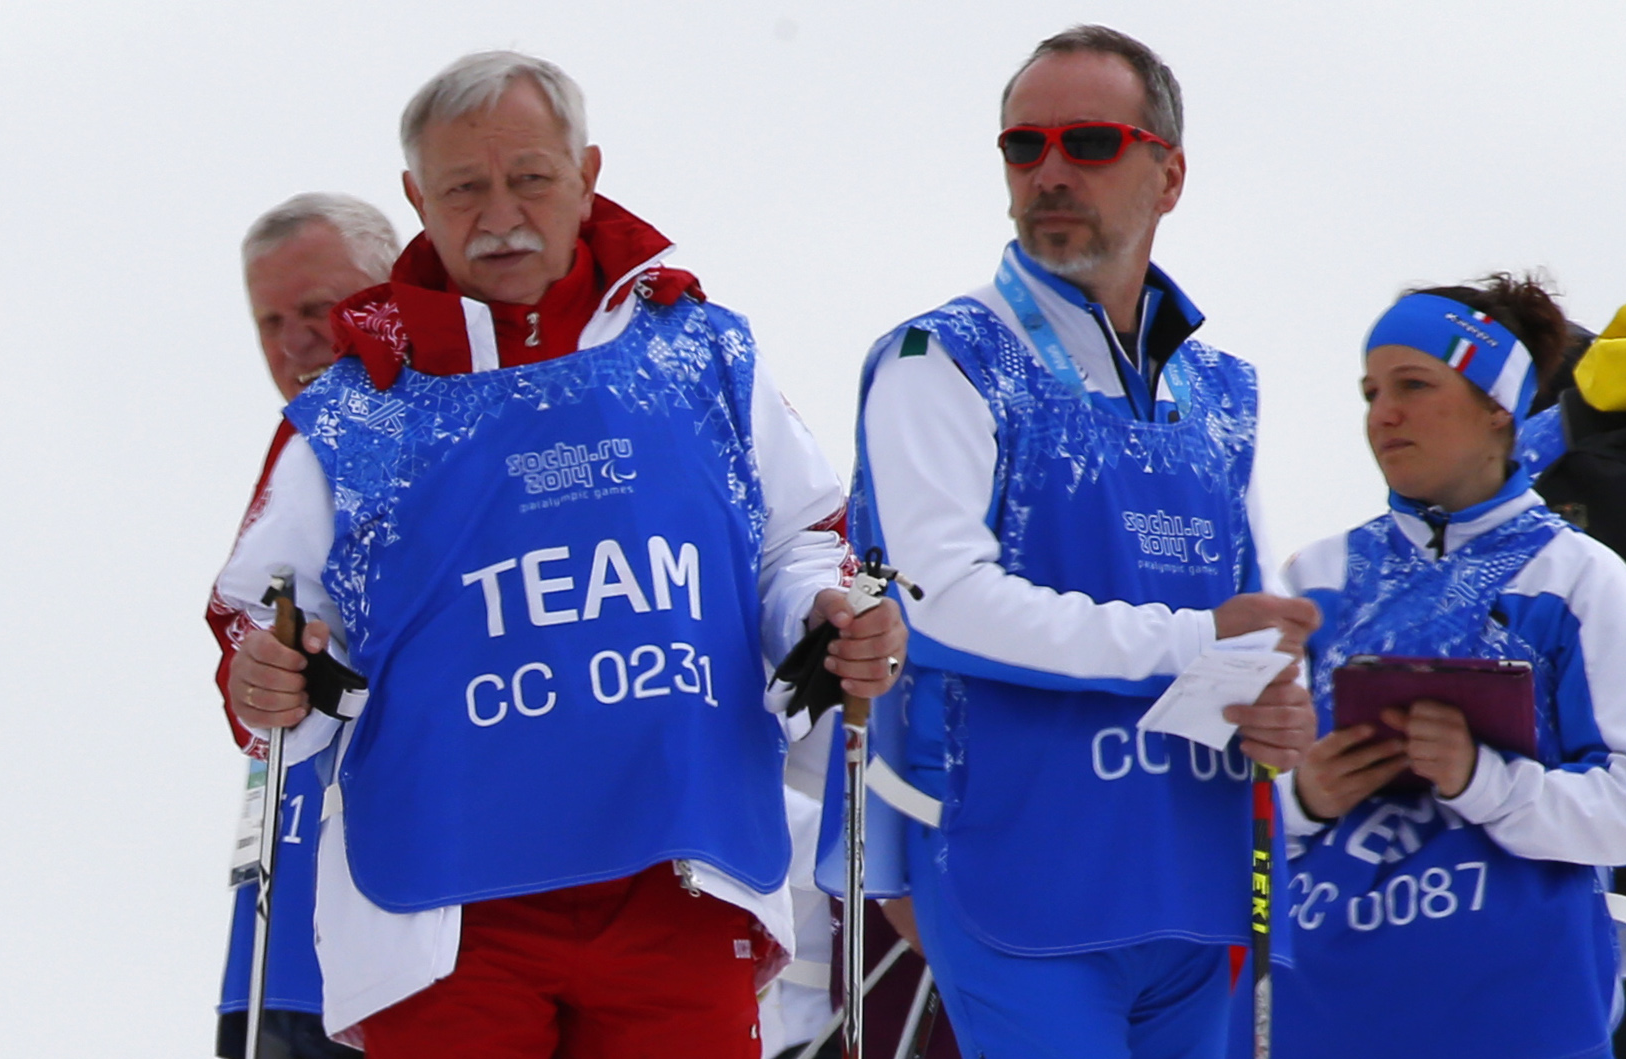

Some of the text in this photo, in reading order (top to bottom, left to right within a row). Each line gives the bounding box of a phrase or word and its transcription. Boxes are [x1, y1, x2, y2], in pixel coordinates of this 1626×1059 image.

[505, 438, 633, 476] sochi.ru
[524, 463, 593, 494] 2014
[519, 485, 634, 513] paralympic games
[1122, 509, 1214, 539] sochi.ru
[462, 535, 702, 638] TEAM
[465, 642, 718, 727] CC 0231
[1092, 727, 1171, 781] CC
[1252, 850, 1271, 934] LEKI
[1347, 861, 1487, 932] 0087
